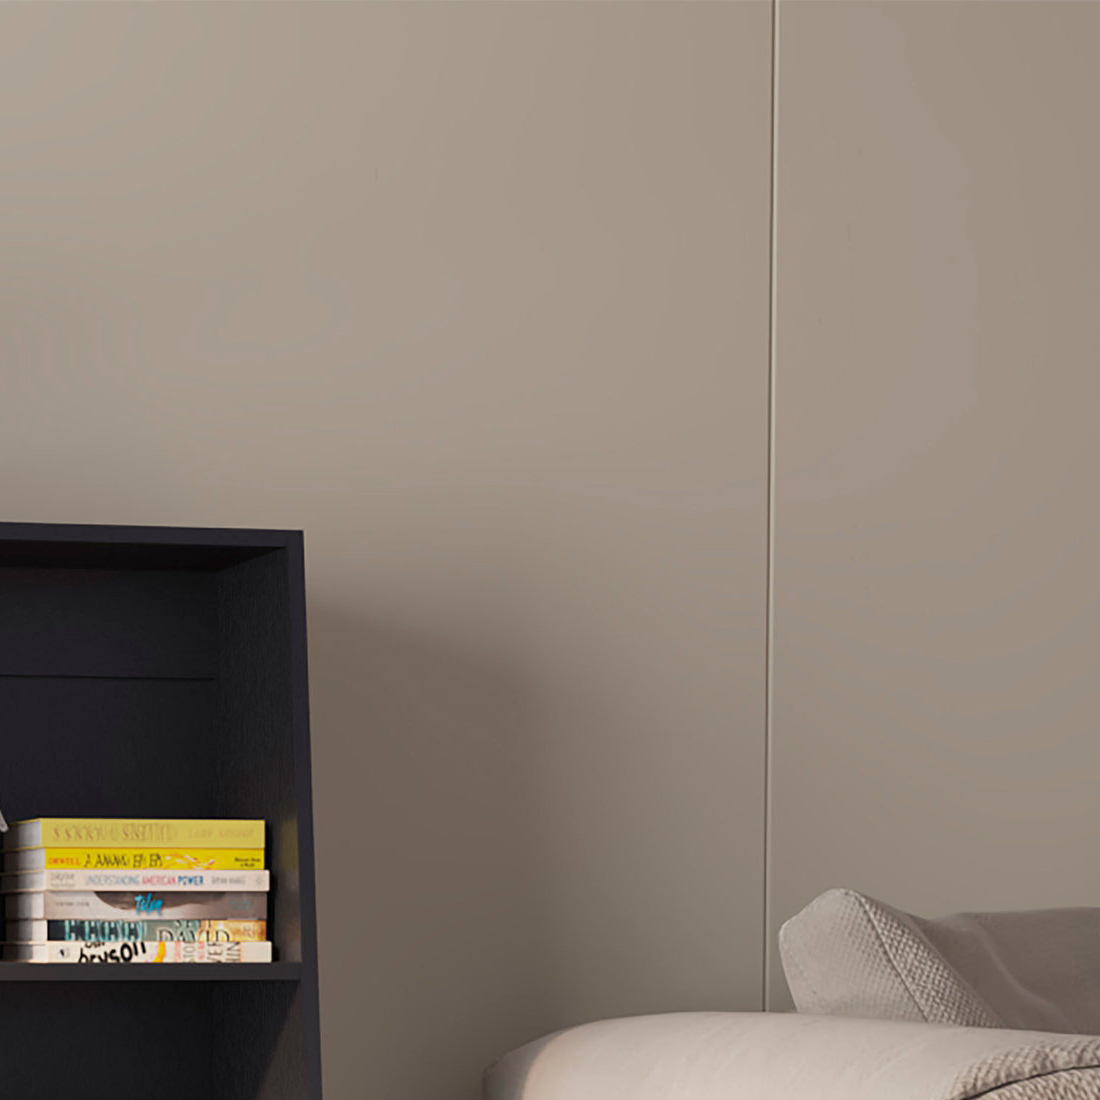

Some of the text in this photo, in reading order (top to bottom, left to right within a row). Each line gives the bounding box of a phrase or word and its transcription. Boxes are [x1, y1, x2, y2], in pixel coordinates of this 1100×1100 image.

[84, 874, 140, 886] UNDERSTANDING
[141, 875, 176, 886] AMERICAN
[177, 875, 204, 886] POWER
